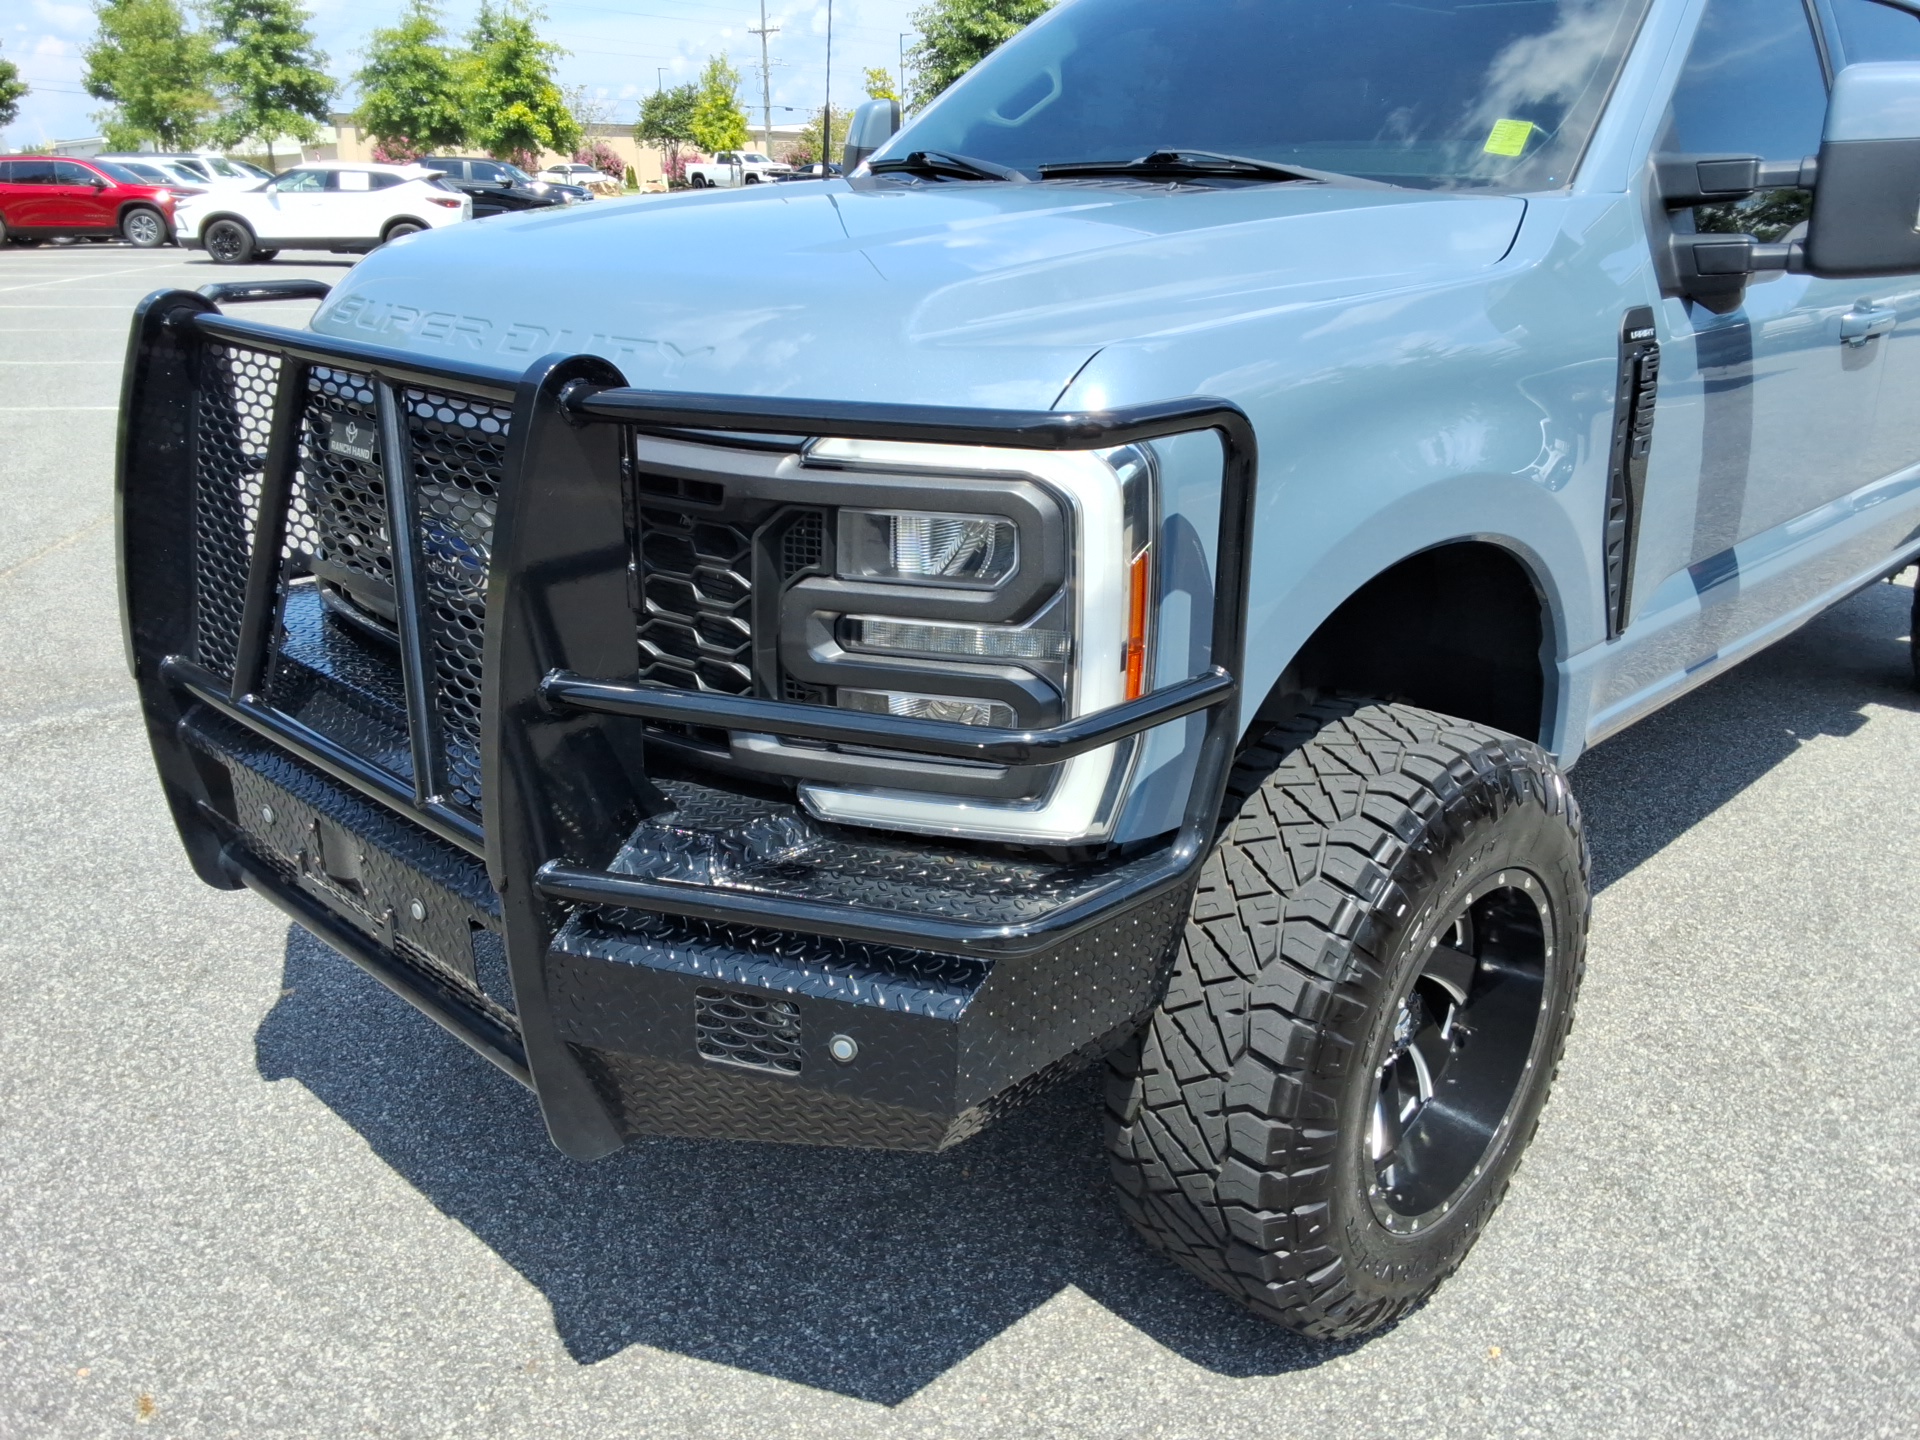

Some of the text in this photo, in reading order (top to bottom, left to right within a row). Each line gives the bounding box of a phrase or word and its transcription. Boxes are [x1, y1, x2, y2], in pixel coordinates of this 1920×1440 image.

[330, 293, 717, 380] SUPER DUTY
[331, 440, 370, 459] RANCH HAND
